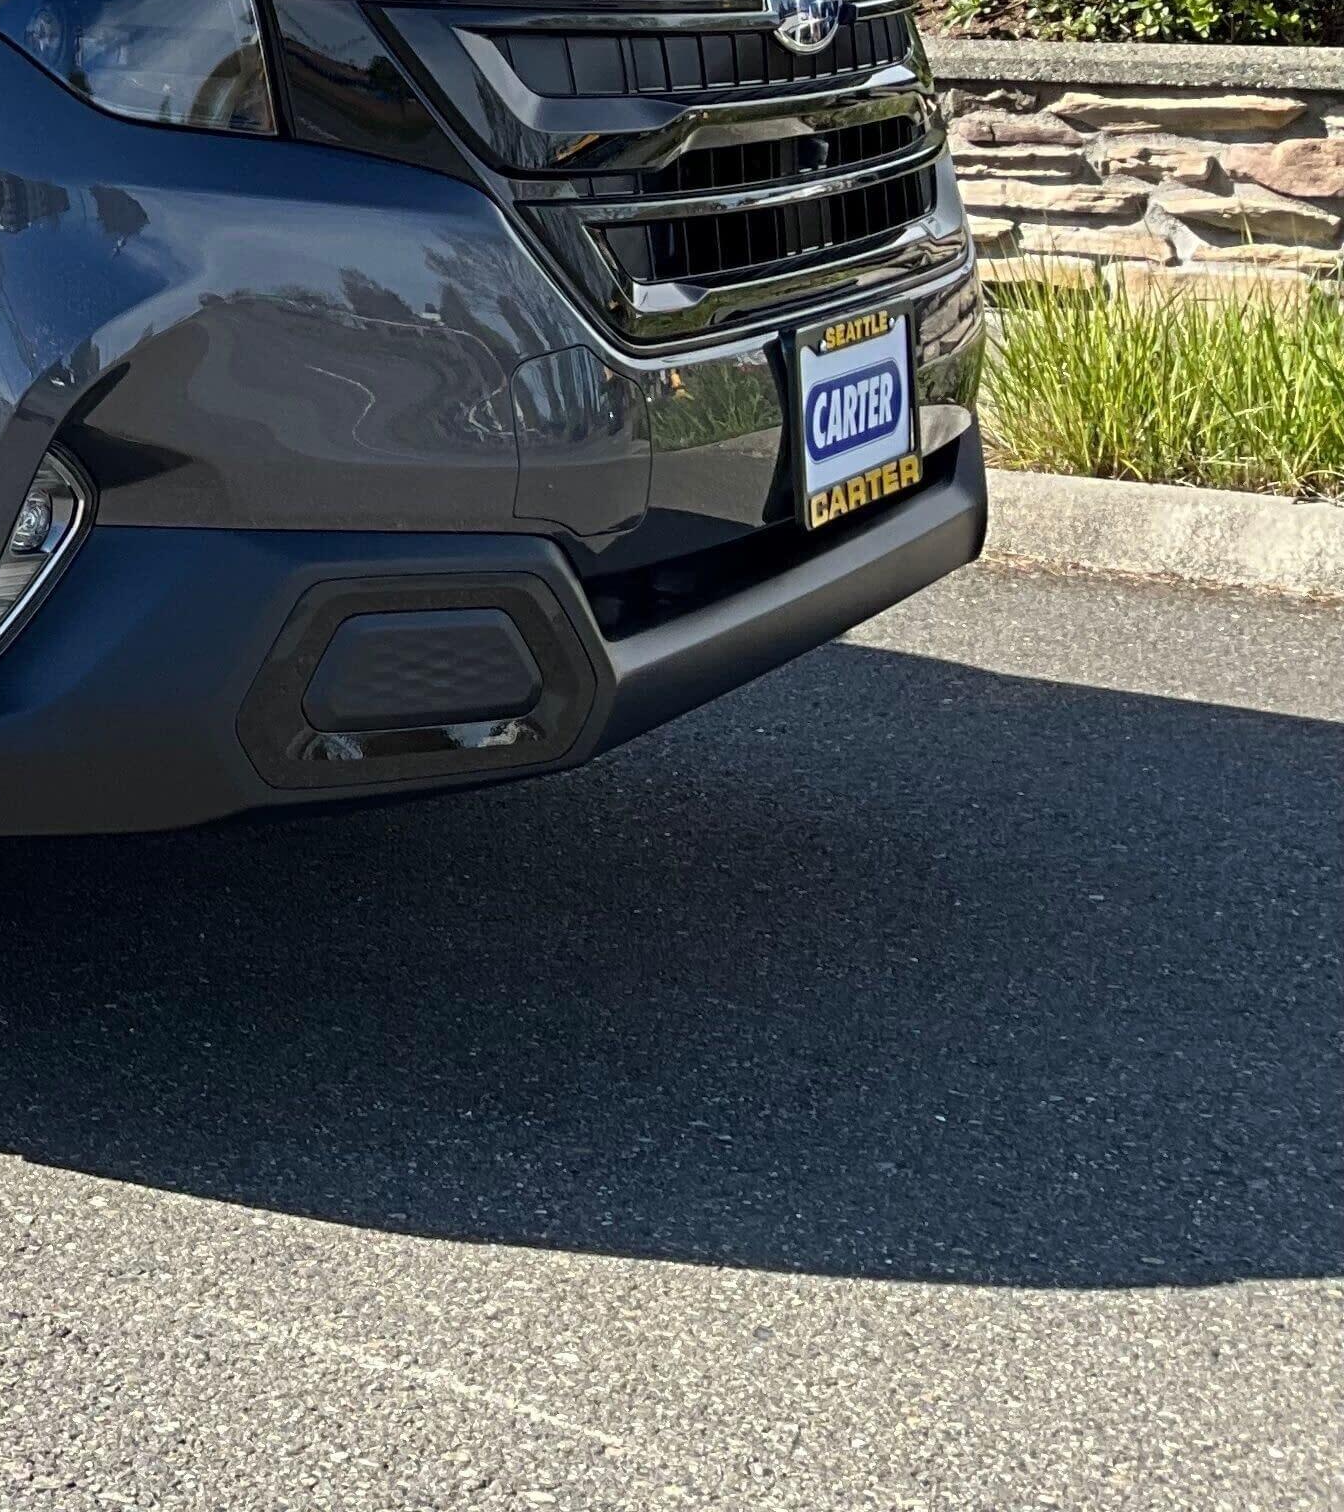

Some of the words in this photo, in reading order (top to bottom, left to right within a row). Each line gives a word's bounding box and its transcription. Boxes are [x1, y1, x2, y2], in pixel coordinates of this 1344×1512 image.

[826, 310, 889, 350] SEATTLE
[814, 372, 893, 450] CARTER
[812, 455, 919, 528] CARTER
